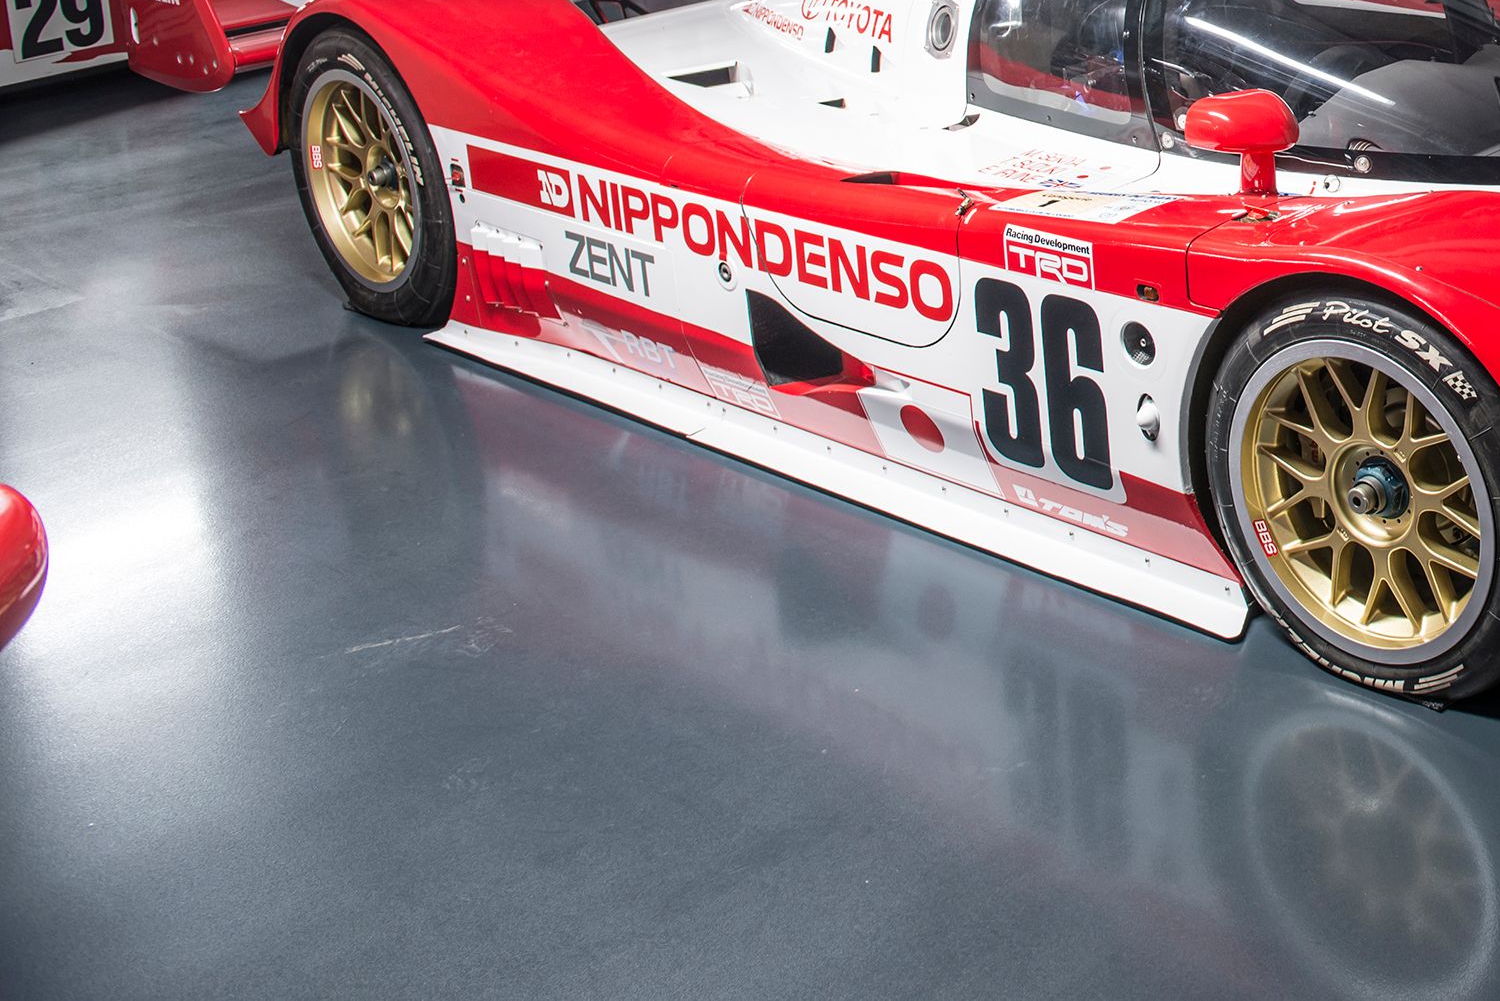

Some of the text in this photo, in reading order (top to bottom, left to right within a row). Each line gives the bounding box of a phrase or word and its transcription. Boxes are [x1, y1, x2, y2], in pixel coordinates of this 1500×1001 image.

[311, 145, 323, 169] BBS
[364, 72, 425, 188] MICHELIN
[564, 230, 655, 297] ZENT
[577, 173, 953, 322] NIPPONDENSO
[1006, 227, 1090, 255] Racing Development
[1008, 244, 1089, 285] TRD
[1322, 300, 1454, 373] Pilot SX
[975, 277, 1114, 491] 36
[1254, 518, 1277, 557] BBS
